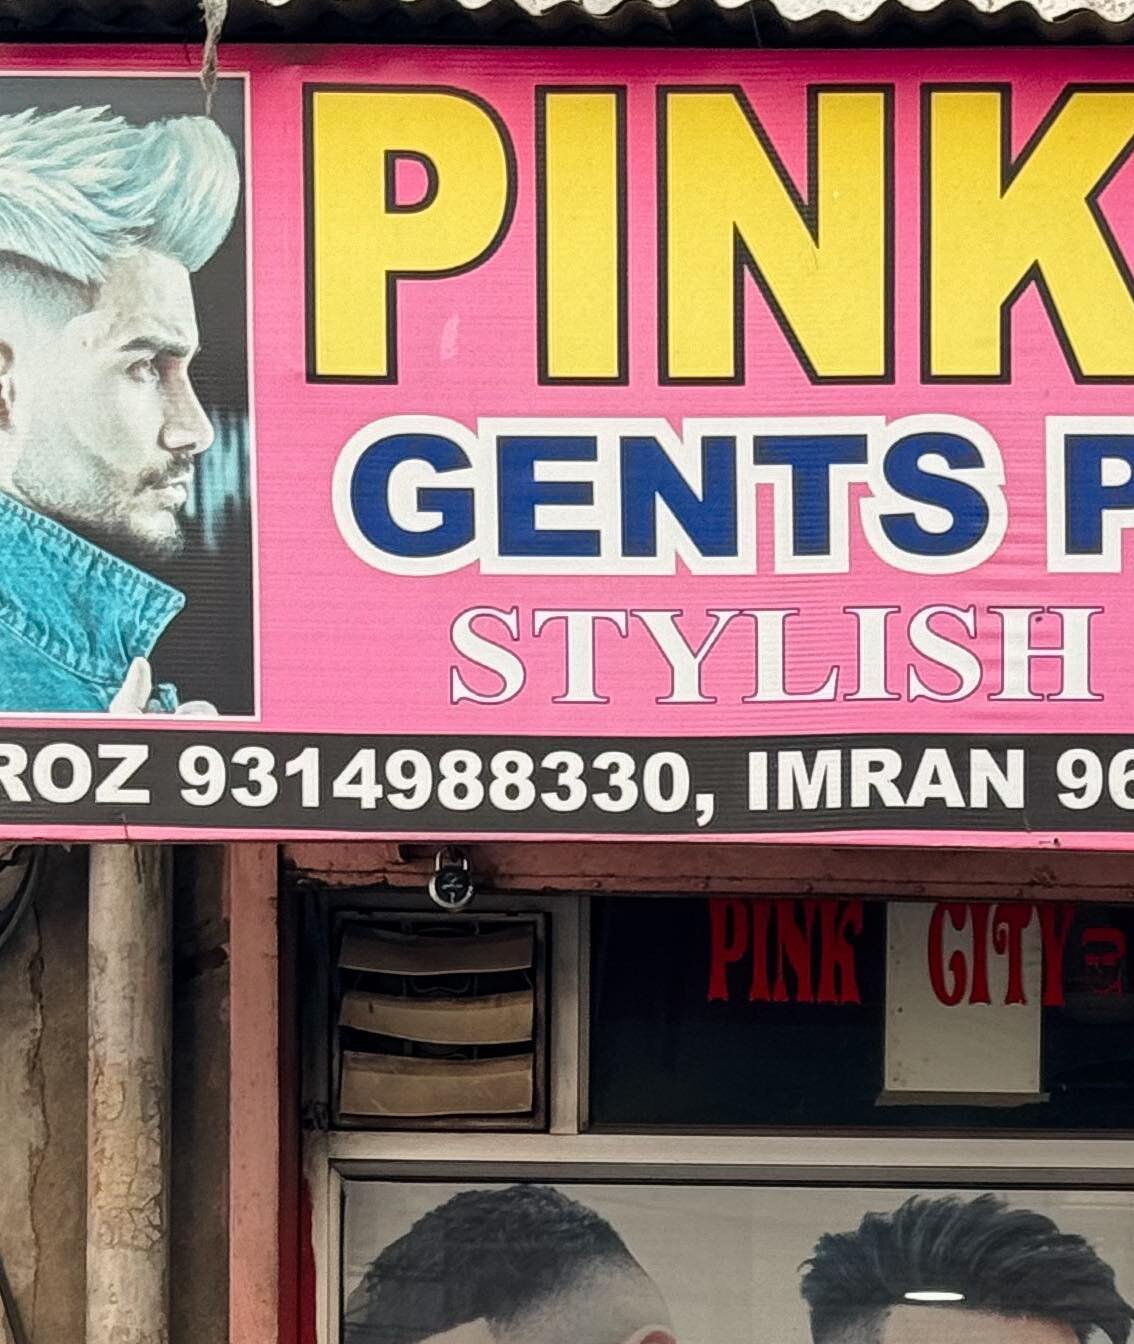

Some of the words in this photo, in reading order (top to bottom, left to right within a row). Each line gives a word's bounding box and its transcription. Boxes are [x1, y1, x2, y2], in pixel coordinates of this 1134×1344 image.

[334, 415, 1006, 574] GENTS
[449, 604, 1104, 707] STYLISH
[178, 745, 714, 827] 9314988330,
[748, 748, 1025, 811] IMRAN
[707, 897, 864, 1004] PINK
[927, 900, 1075, 1007] CITY
